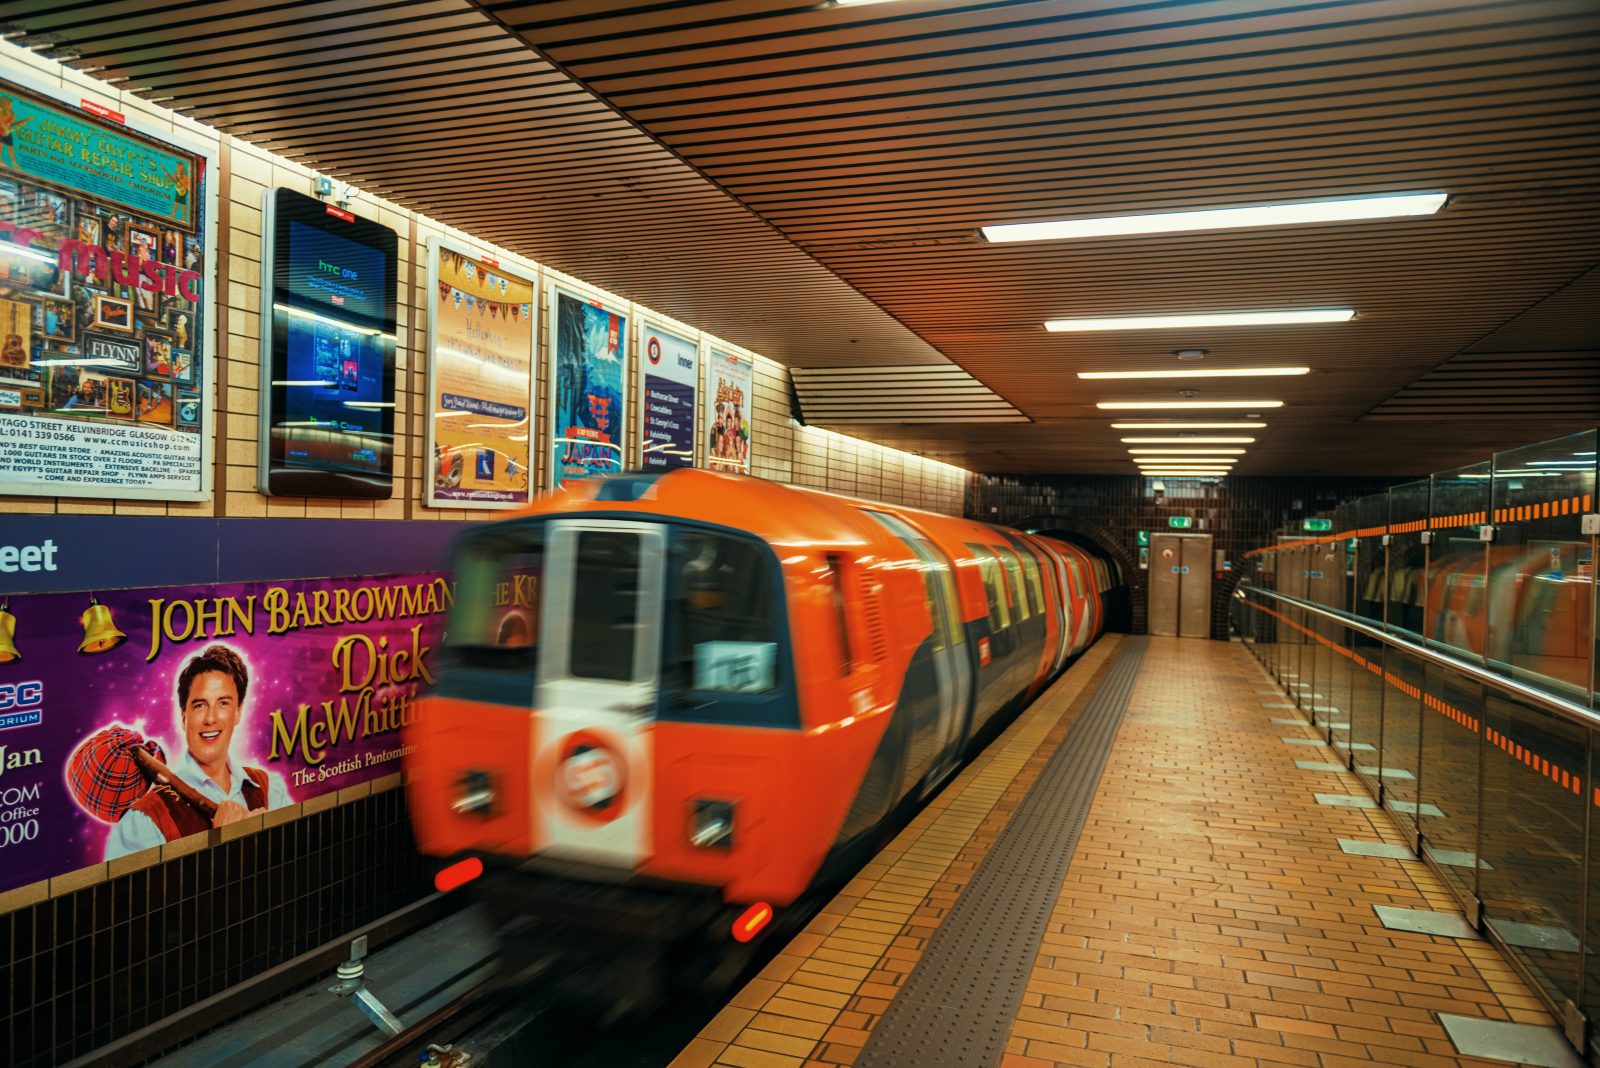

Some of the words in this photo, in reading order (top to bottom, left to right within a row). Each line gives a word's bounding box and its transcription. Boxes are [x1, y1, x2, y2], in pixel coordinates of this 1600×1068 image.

[39, 119, 91, 146] JIMMY
[15, 126, 74, 158] GUITAR
[81, 147, 134, 178] REPAIR
[139, 169, 176, 190] SHOP
[58, 238, 200, 303] music
[319, 260, 340, 275] htc
[92, 341, 137, 363] FLYNN
[677, 352, 693, 369] Inner
[0, 418, 28, 429] TAGO
[29, 420, 63, 431] STREET
[66, 424, 126, 437] KELVINBRIDGE
[129, 430, 167, 441] GLASGOW
[10, 428, 32, 437] 0141
[35, 430, 52, 439] 339
[53, 432, 75, 442] 0566
[84, 436, 190, 452] www.ccmusicshop.com
[0, 441, 17, 449] ND'S
[18, 442, 38, 450] BEST
[39, 444, 67, 452] GUITAR
[68, 446, 91, 454] STORE
[100, 449, 130, 457] AMAZING
[131, 451, 162, 460] ACOUSTIC
[163, 453, 186, 461] GUITAR
[24, 451, 57, 459] GUITARS
[59, 452, 68, 460] IN
[69, 453, 92, 461] STOCK
[93, 455, 111, 463] OVER
[118, 457, 143, 465] FLOORS
[162, 460, 196, 468] SPECIALIST
[562, 440, 611, 468] JAPAN
[12, 465, 43, 473] EGYPT'S
[45, 467, 72, 475] GUITAR
[74, 468, 100, 476] REPAIR
[128, 471, 148, 479] FLYNN
[14, 457, 41, 465] WORLD
[43, 459, 94, 469] INSTRUMENTS
[104, 463, 140, 471] EXTENSIVE
[141, 465, 171, 473] BACKLINE
[83, 476, 124, 485] EXPERIENCE
[0, 539, 58, 573] eet
[146, 595, 257, 662] JOHN
[264, 577, 458, 634] BARROWMAN
[332, 623, 437, 694] Dick
[0, 680, 43, 710] CC
[0, 714, 39, 727] ORIUM
[0, 745, 43, 776] Jan
[292, 767, 316, 788] The
[318, 753, 362, 782] Scottish
[1, 806, 40, 823] Office
[0, 818, 39, 848] 000
